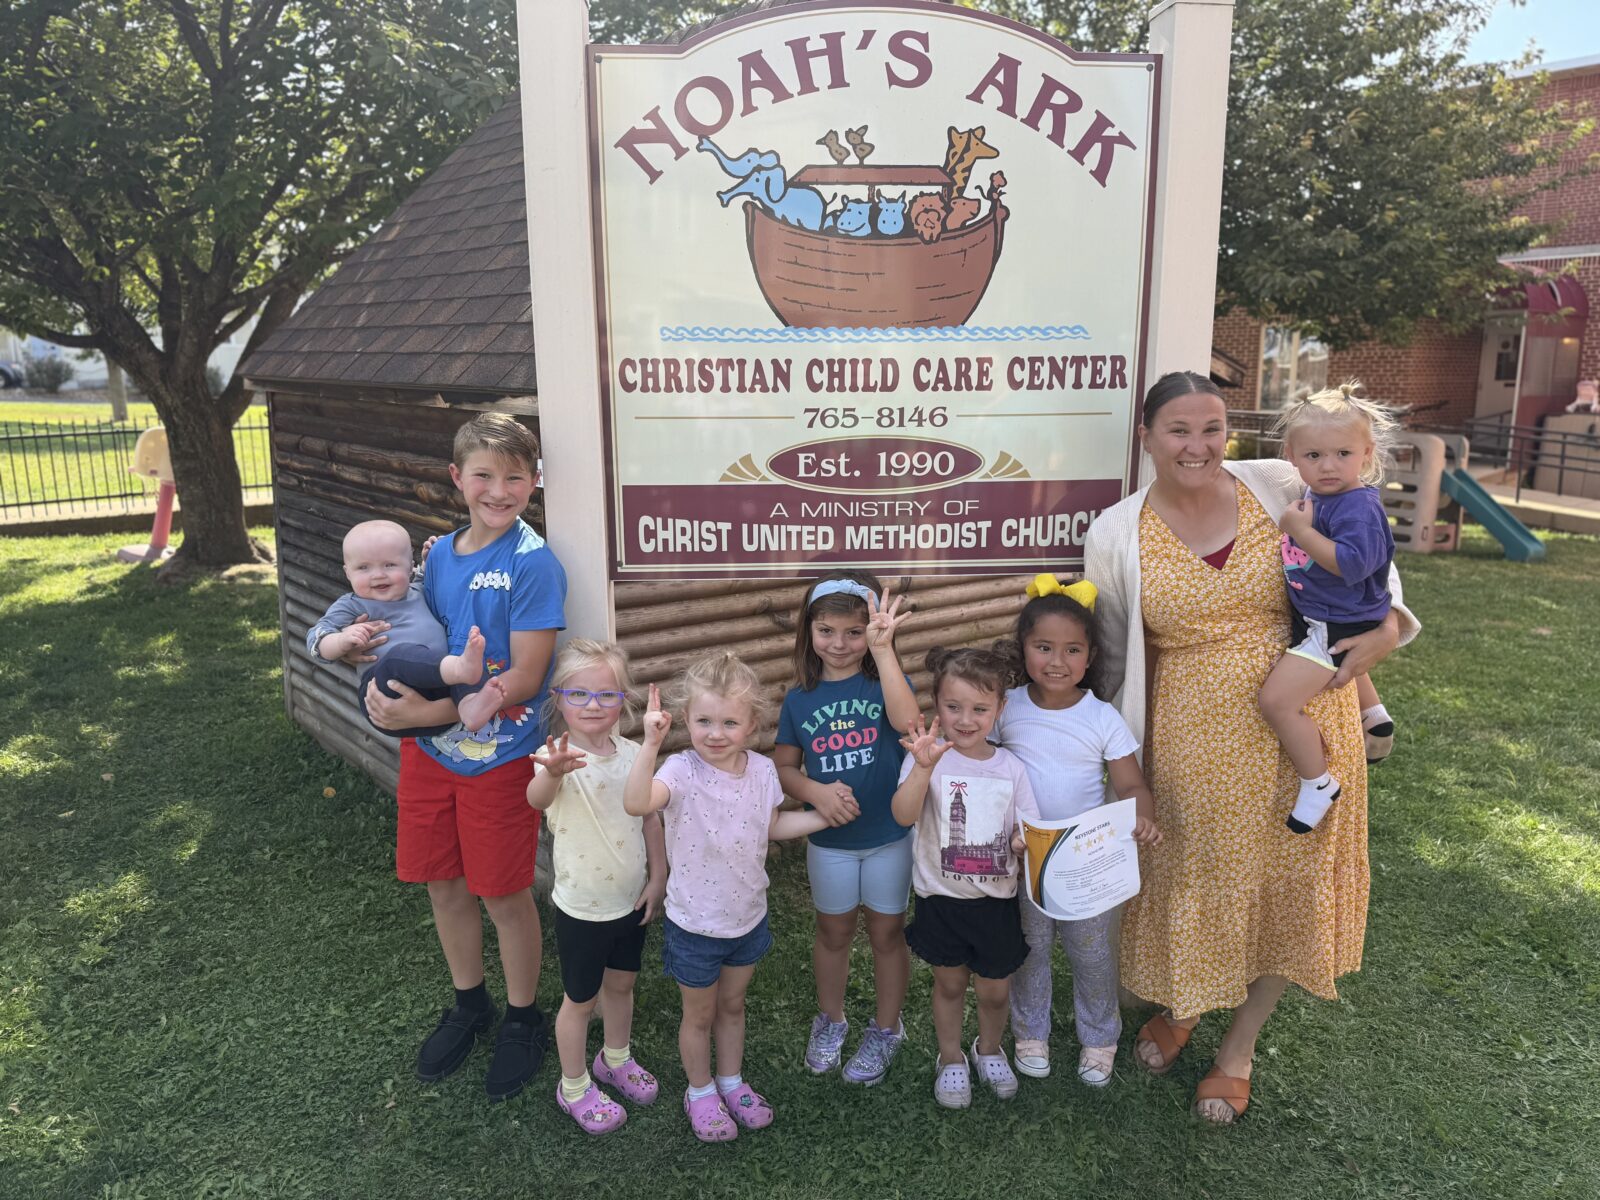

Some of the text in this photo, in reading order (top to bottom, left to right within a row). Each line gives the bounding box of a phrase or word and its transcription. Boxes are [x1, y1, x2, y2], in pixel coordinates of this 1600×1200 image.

[614, 30, 1137, 187] NOAH'S ARK
[619, 354, 1128, 393] CHRISTIAN CHILD CARE CENTER
[803, 405, 948, 429] 765-8146
[797, 451, 955, 477] Est. 1990
[769, 500, 980, 518] A MINISTRY OF
[638, 509, 1103, 553] CHRIST UNITED METHODIST CHURC
[801, 699, 881, 735] LIVING
[829, 720, 856, 731] the
[812, 727, 878, 753] GOOD
[820, 747, 875, 773] LIFE
[941, 870, 1009, 884] LONDO
